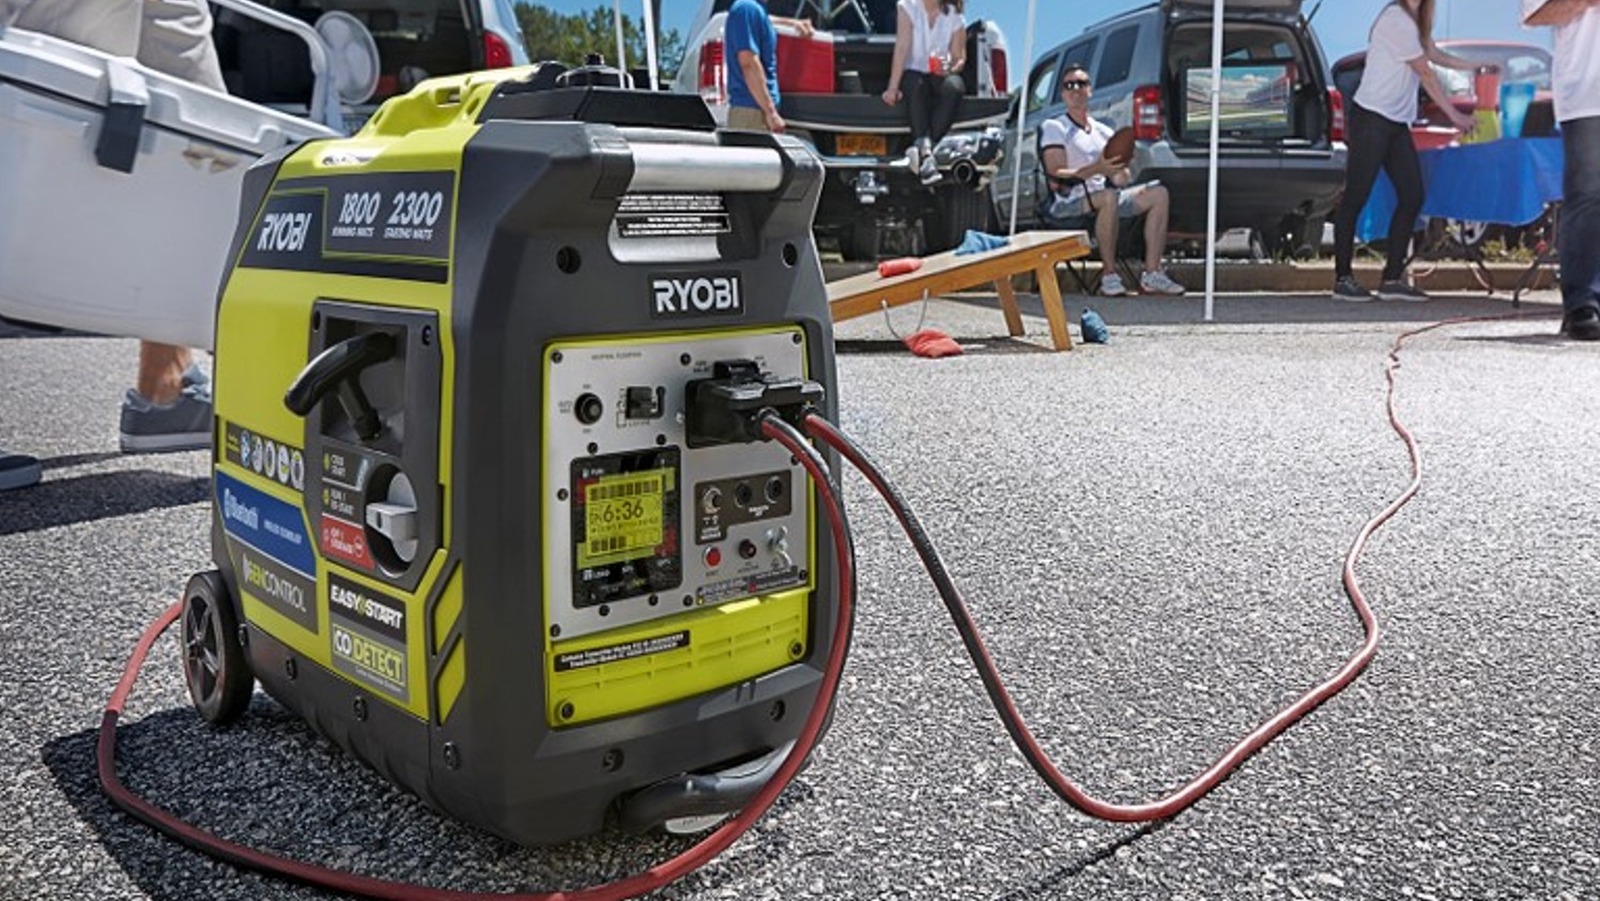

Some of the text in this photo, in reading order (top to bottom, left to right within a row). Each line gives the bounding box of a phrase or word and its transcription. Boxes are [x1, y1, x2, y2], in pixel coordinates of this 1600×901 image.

[338, 191, 444, 227] 1800 2300
[257, 212, 312, 251] RYOBI
[652, 277, 740, 313] RYOBI
[603, 499, 644, 523] 6:36
[330, 584, 404, 630] EASY START
[334, 629, 352, 656] CO
[353, 637, 403, 682] DETECT
